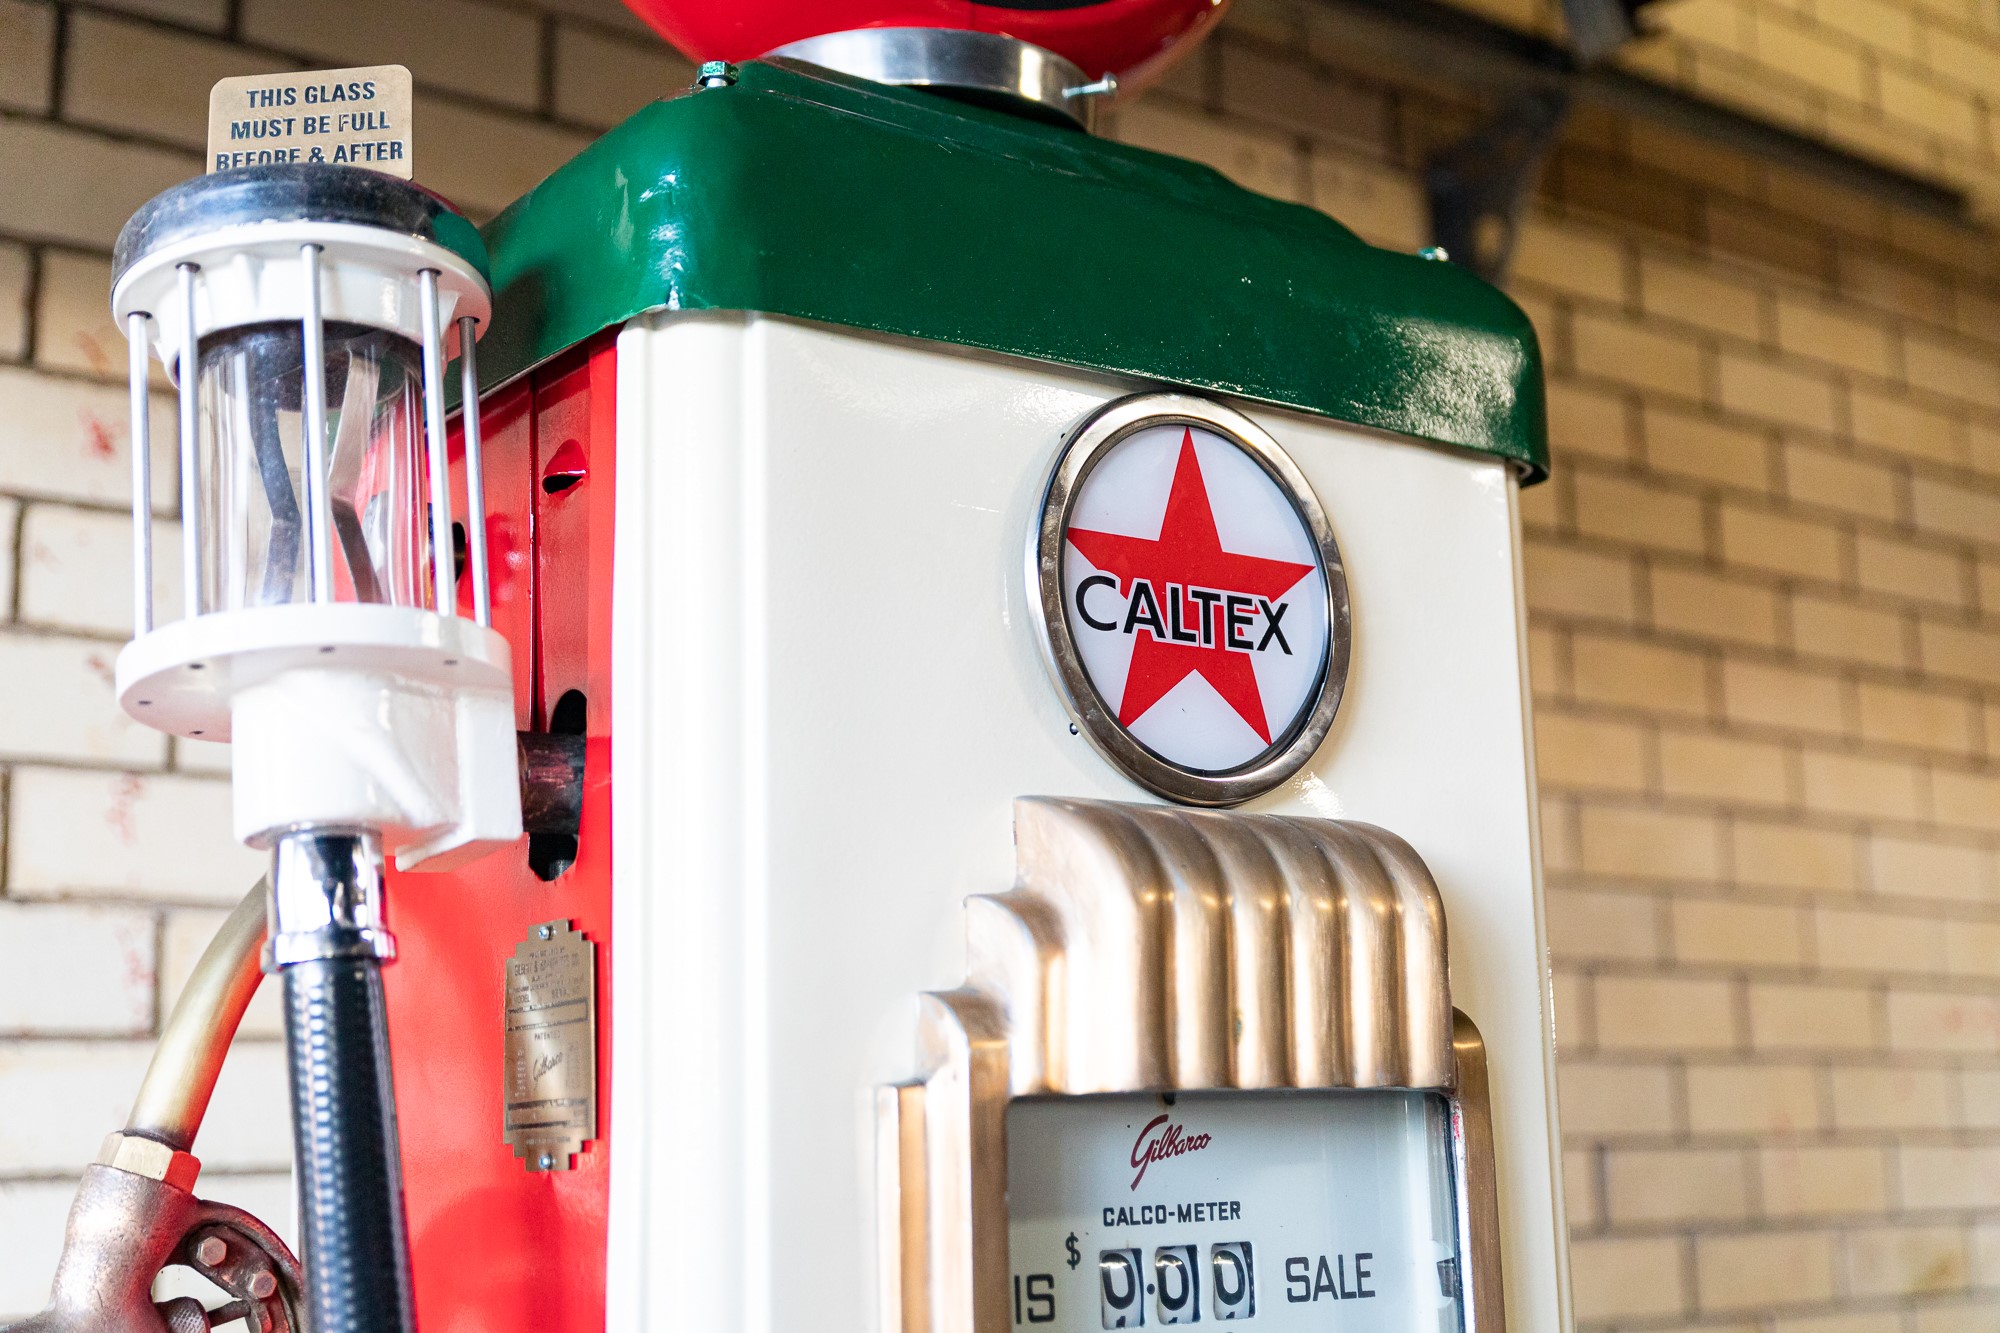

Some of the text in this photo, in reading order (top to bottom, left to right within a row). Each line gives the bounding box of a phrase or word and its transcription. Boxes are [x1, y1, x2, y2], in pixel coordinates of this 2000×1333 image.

[247, 81, 376, 108] THIS GLASS
[231, 111, 390, 140] MUST BE FULL
[216, 141, 404, 171] BEFORE & AFTER
[1075, 575, 1293, 655] CALTEX
[1130, 1113, 1212, 1192] Gilbarco
[1102, 1200, 1241, 1227] CALCO-METER
[1285, 1252, 1376, 1303] SALE
